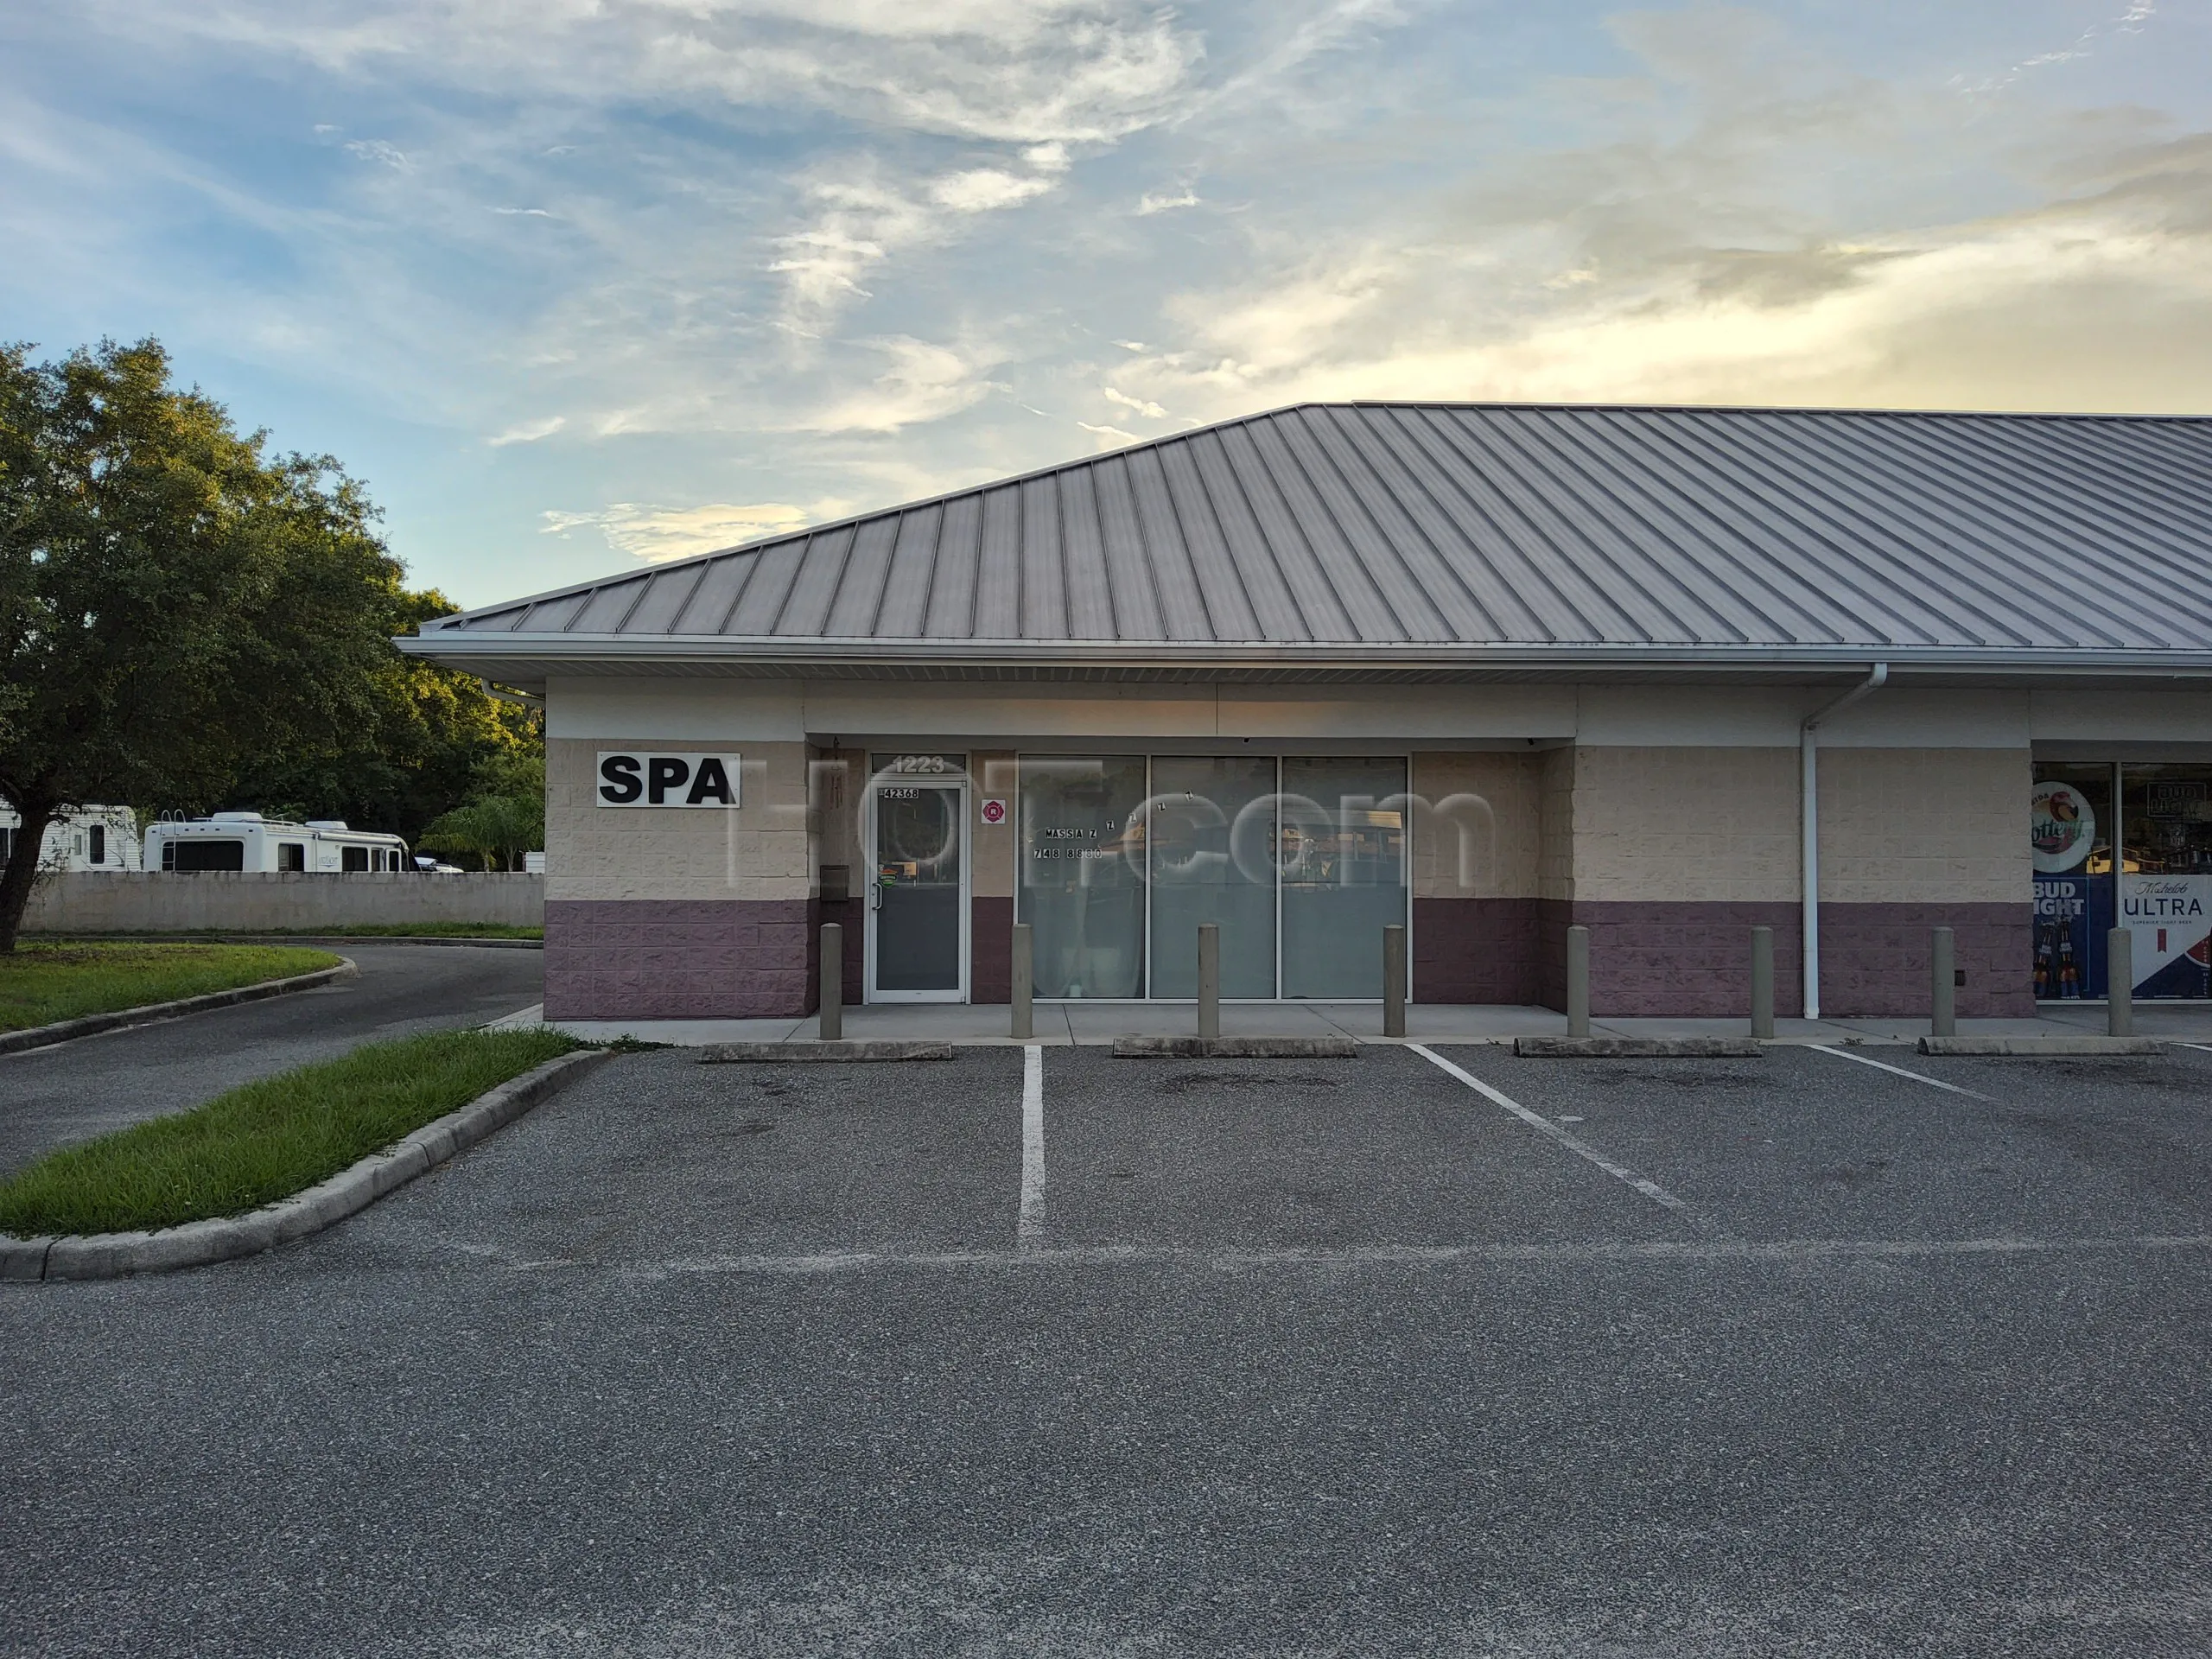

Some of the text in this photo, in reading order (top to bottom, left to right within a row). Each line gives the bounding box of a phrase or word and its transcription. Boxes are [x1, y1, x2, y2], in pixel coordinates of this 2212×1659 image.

[893, 755, 944, 773] 1223
[599, 754, 737, 804] SPA
[885, 789, 918, 798] 42368
[1046, 829, 1083, 839] MASSA
[1090, 829, 1096, 838] Z
[2031, 819, 2082, 842] ottery
[1034, 849, 1060, 858] 748
[2033, 881, 2076, 898] BUD
[2134, 881, 2189, 895] Michelob
[2033, 898, 2085, 915] IGHT
[2124, 898, 2202, 916] ULTRA
